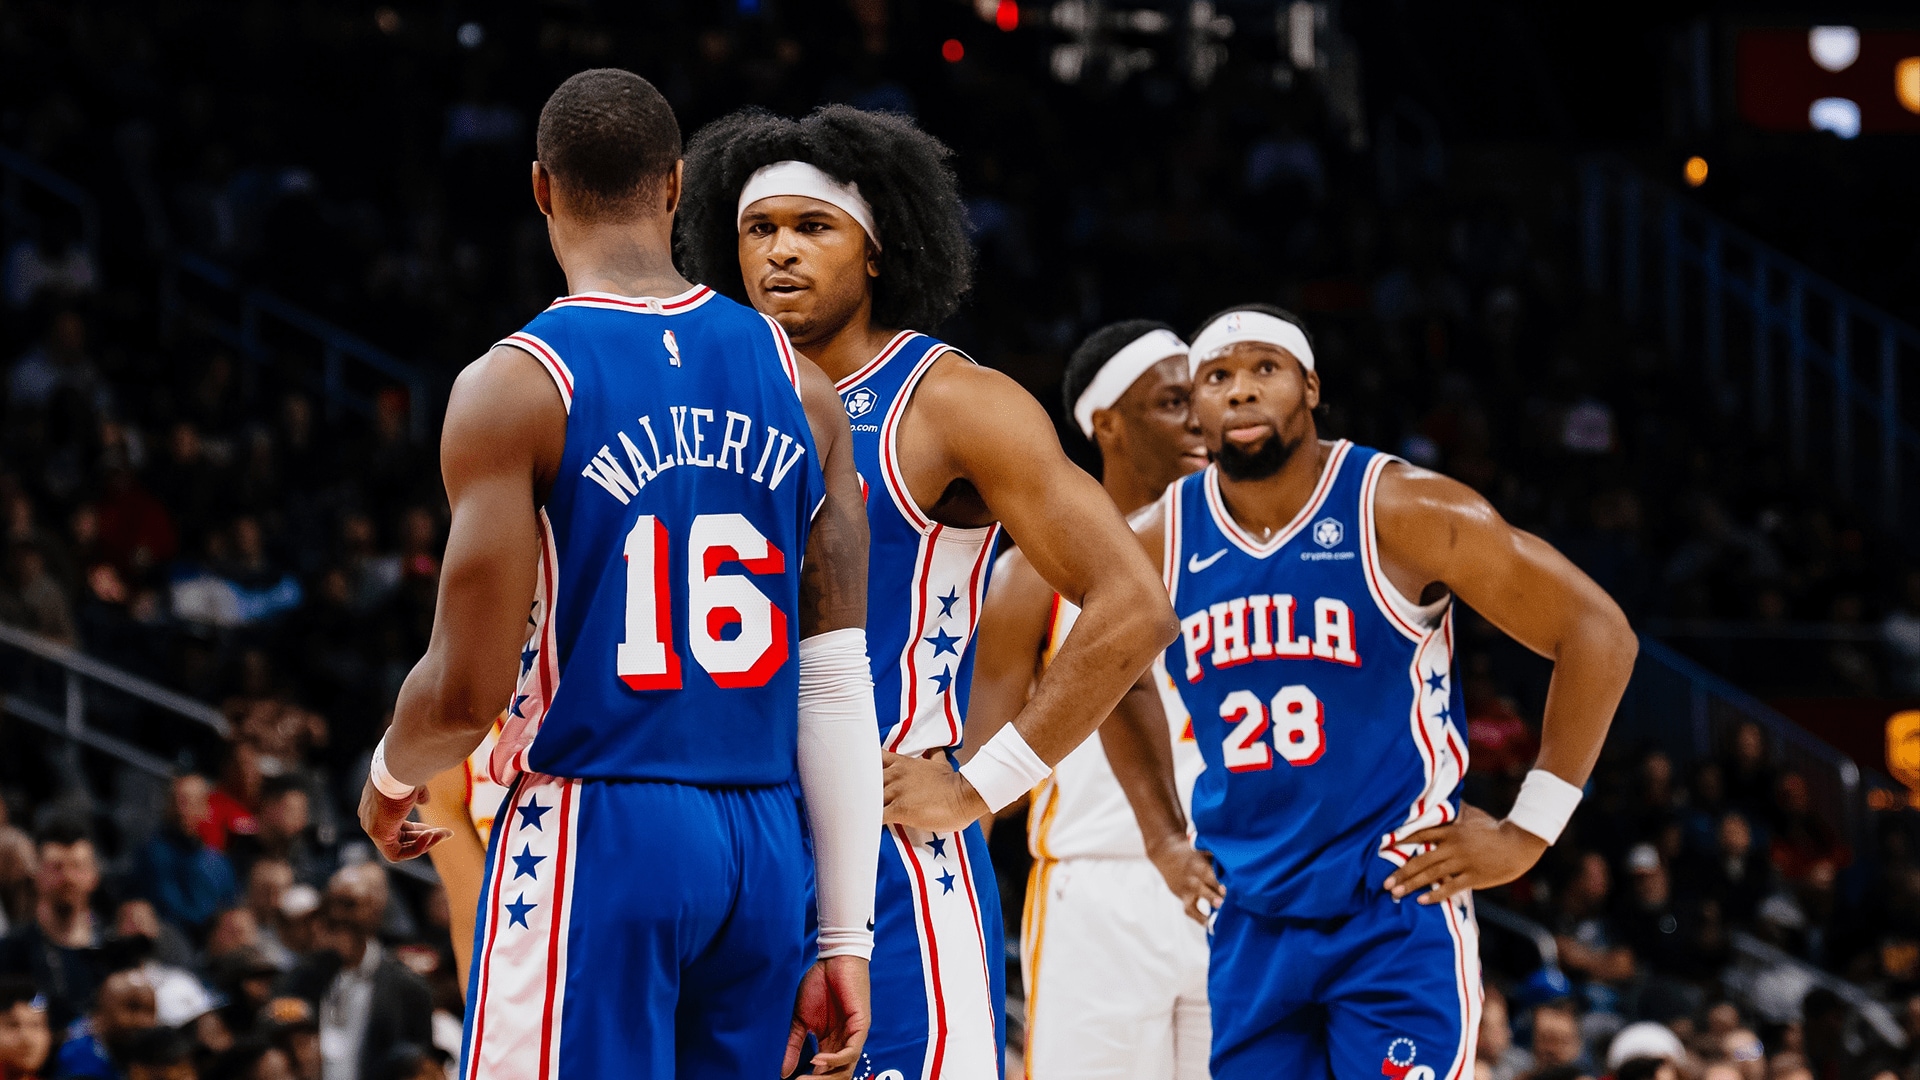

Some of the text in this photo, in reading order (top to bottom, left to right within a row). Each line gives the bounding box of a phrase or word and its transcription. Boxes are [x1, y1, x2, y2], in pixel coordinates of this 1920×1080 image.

[581, 405, 805, 506] WALKER IV
[617, 513, 789, 691] 16
[1180, 594, 1362, 684] PHILA
[1219, 684, 1326, 772] 28
